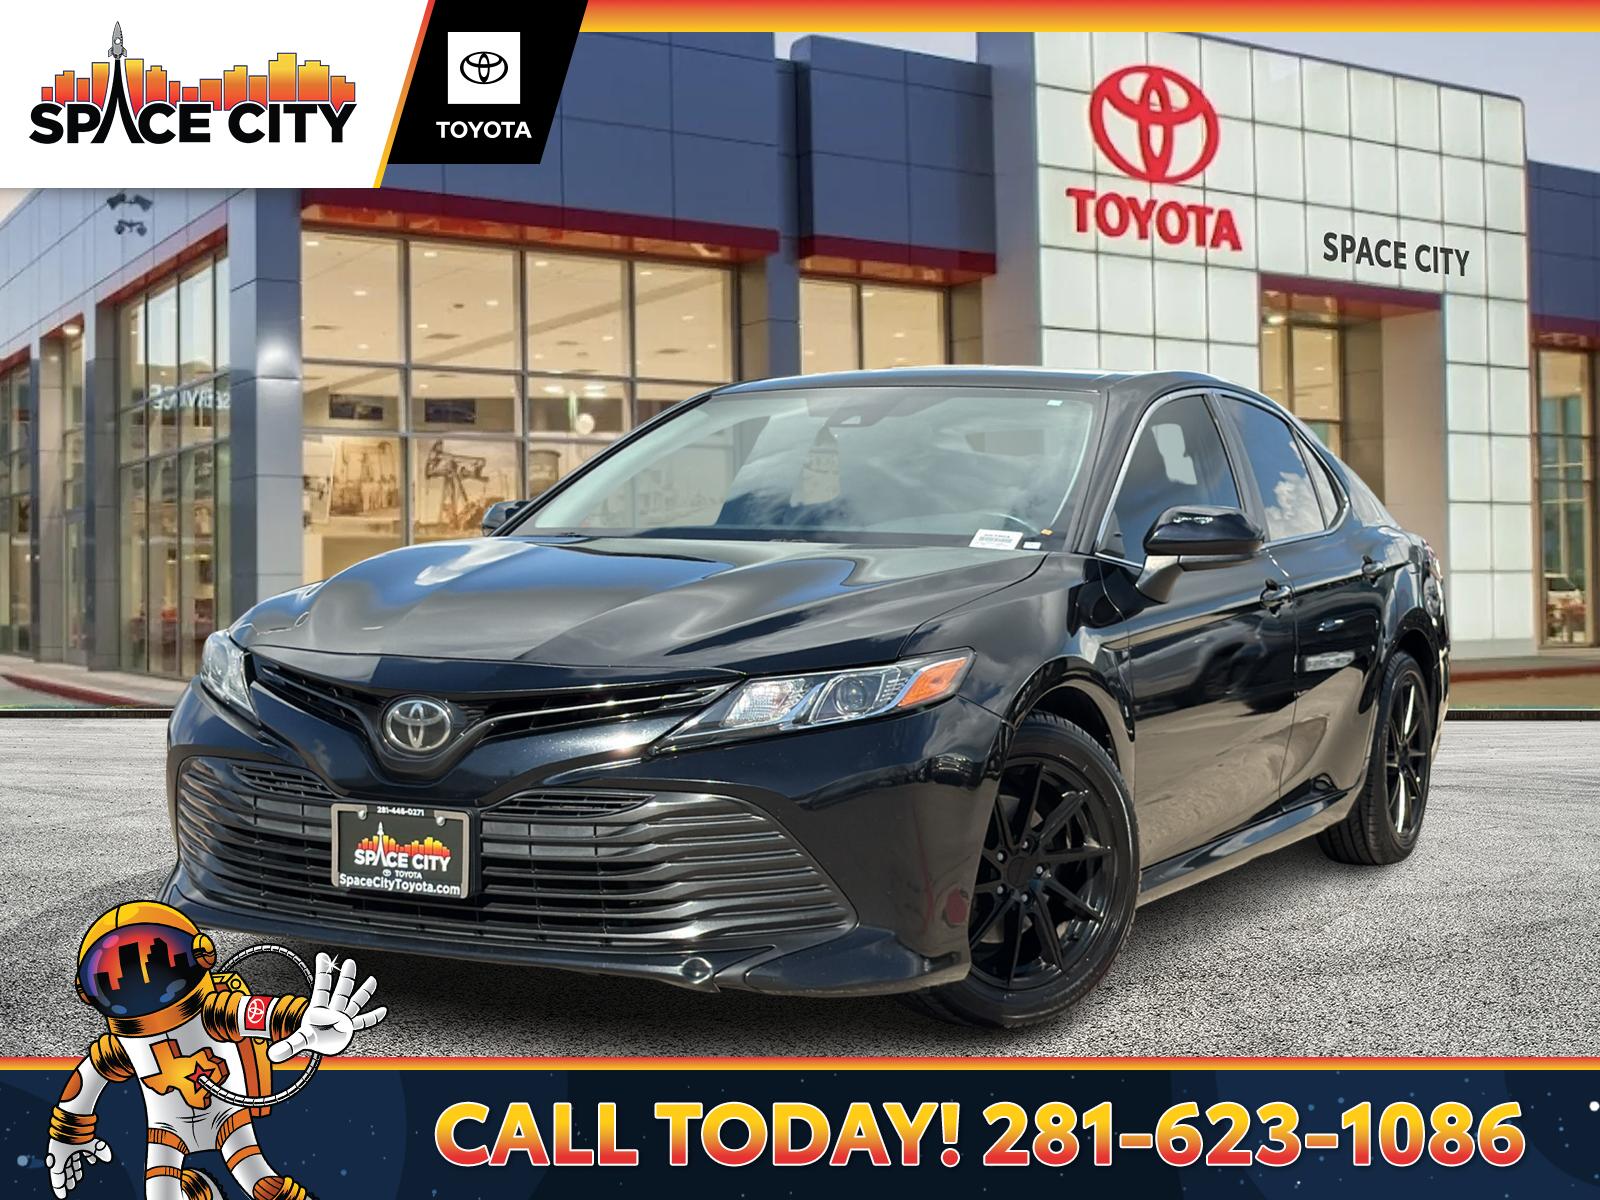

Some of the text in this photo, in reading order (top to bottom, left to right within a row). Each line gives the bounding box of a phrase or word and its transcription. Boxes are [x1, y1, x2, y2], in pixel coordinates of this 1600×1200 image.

[1066, 188, 1243, 251] TOYOTA
[1323, 232, 1470, 277] SPACE CITY
[354, 848, 451, 872] SPACE CITY
[339, 873, 461, 896] SpaceCityToyota.com
[394, 869, 423, 880] TOYOTA
